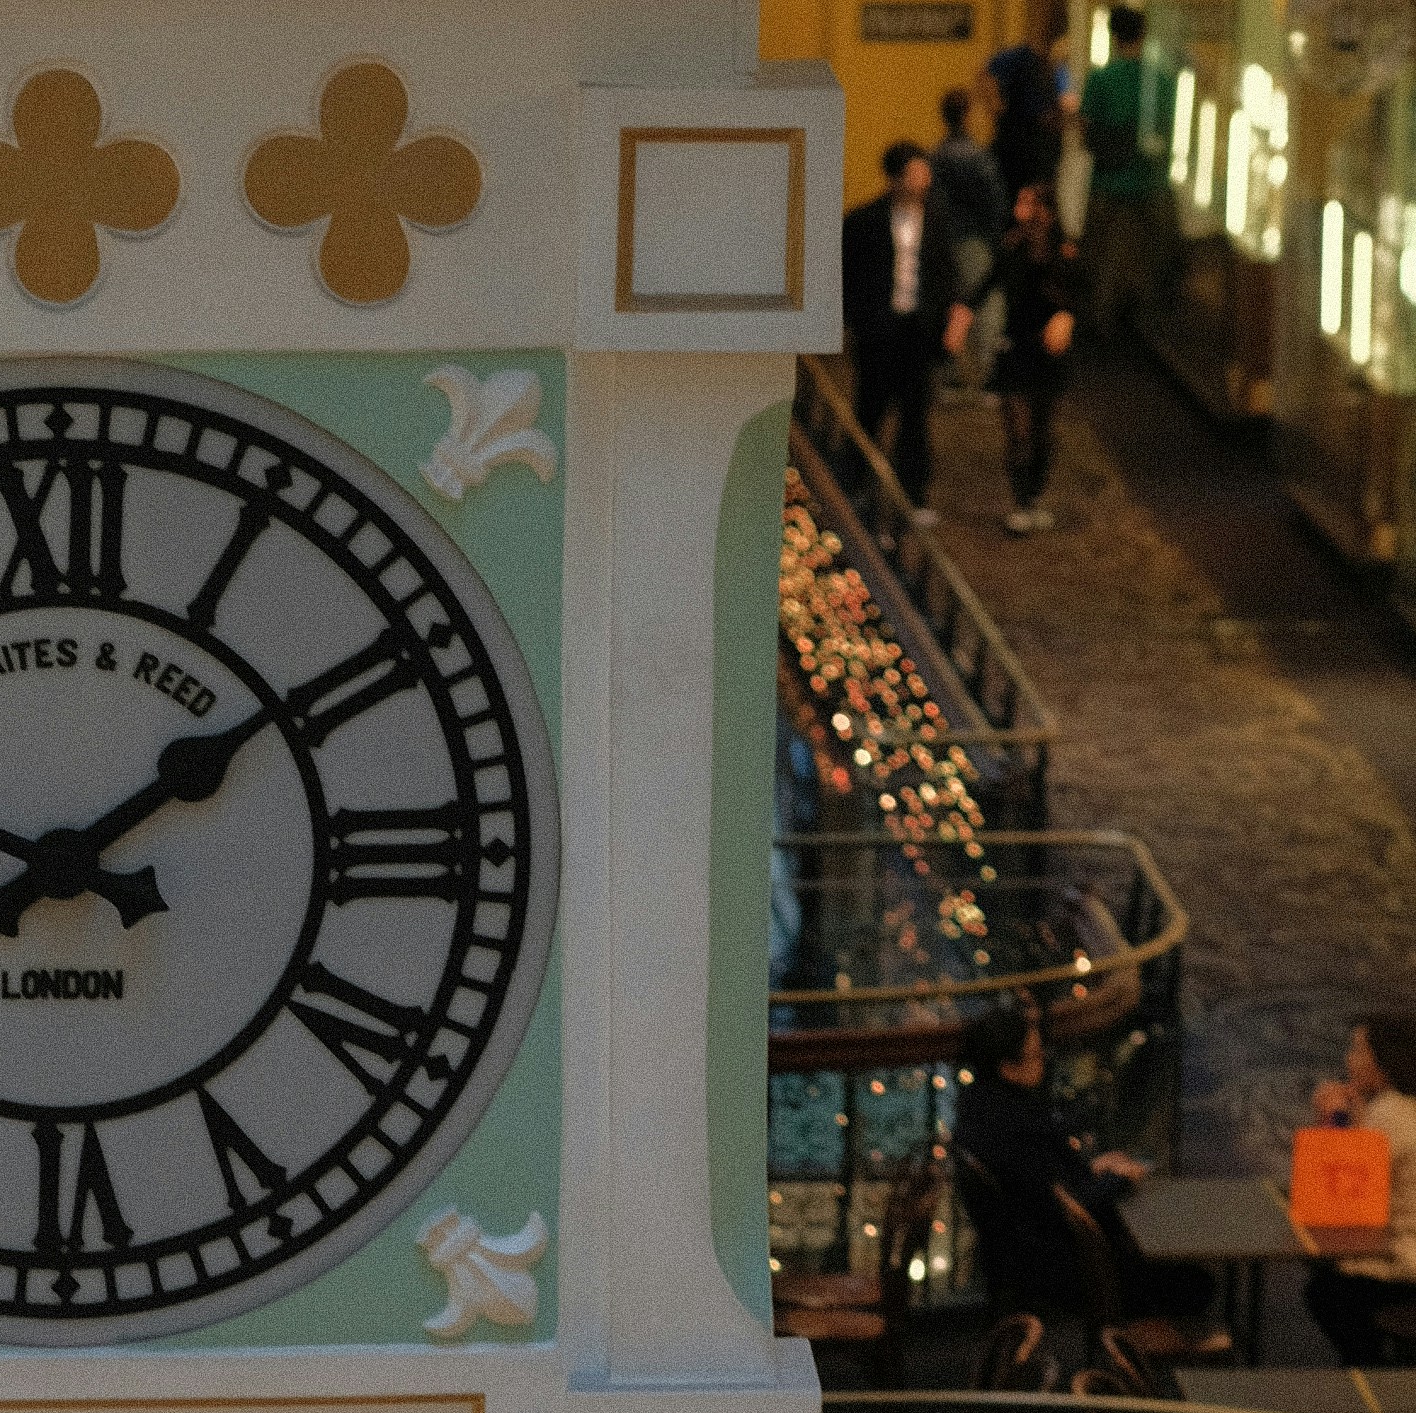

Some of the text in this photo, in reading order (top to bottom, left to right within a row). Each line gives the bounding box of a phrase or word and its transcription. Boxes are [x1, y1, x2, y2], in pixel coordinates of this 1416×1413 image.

[186, 503, 273, 630] I
[94, 642, 117, 671] &
[134, 651, 216, 717] REED
[285, 628, 426, 749] II
[327, 803, 464, 906] III
[1, 970, 124, 1000] LONDON
[283, 961, 429, 1100] IV
[30, 1118, 135, 1251] VI
[193, 1085, 287, 1213] V
